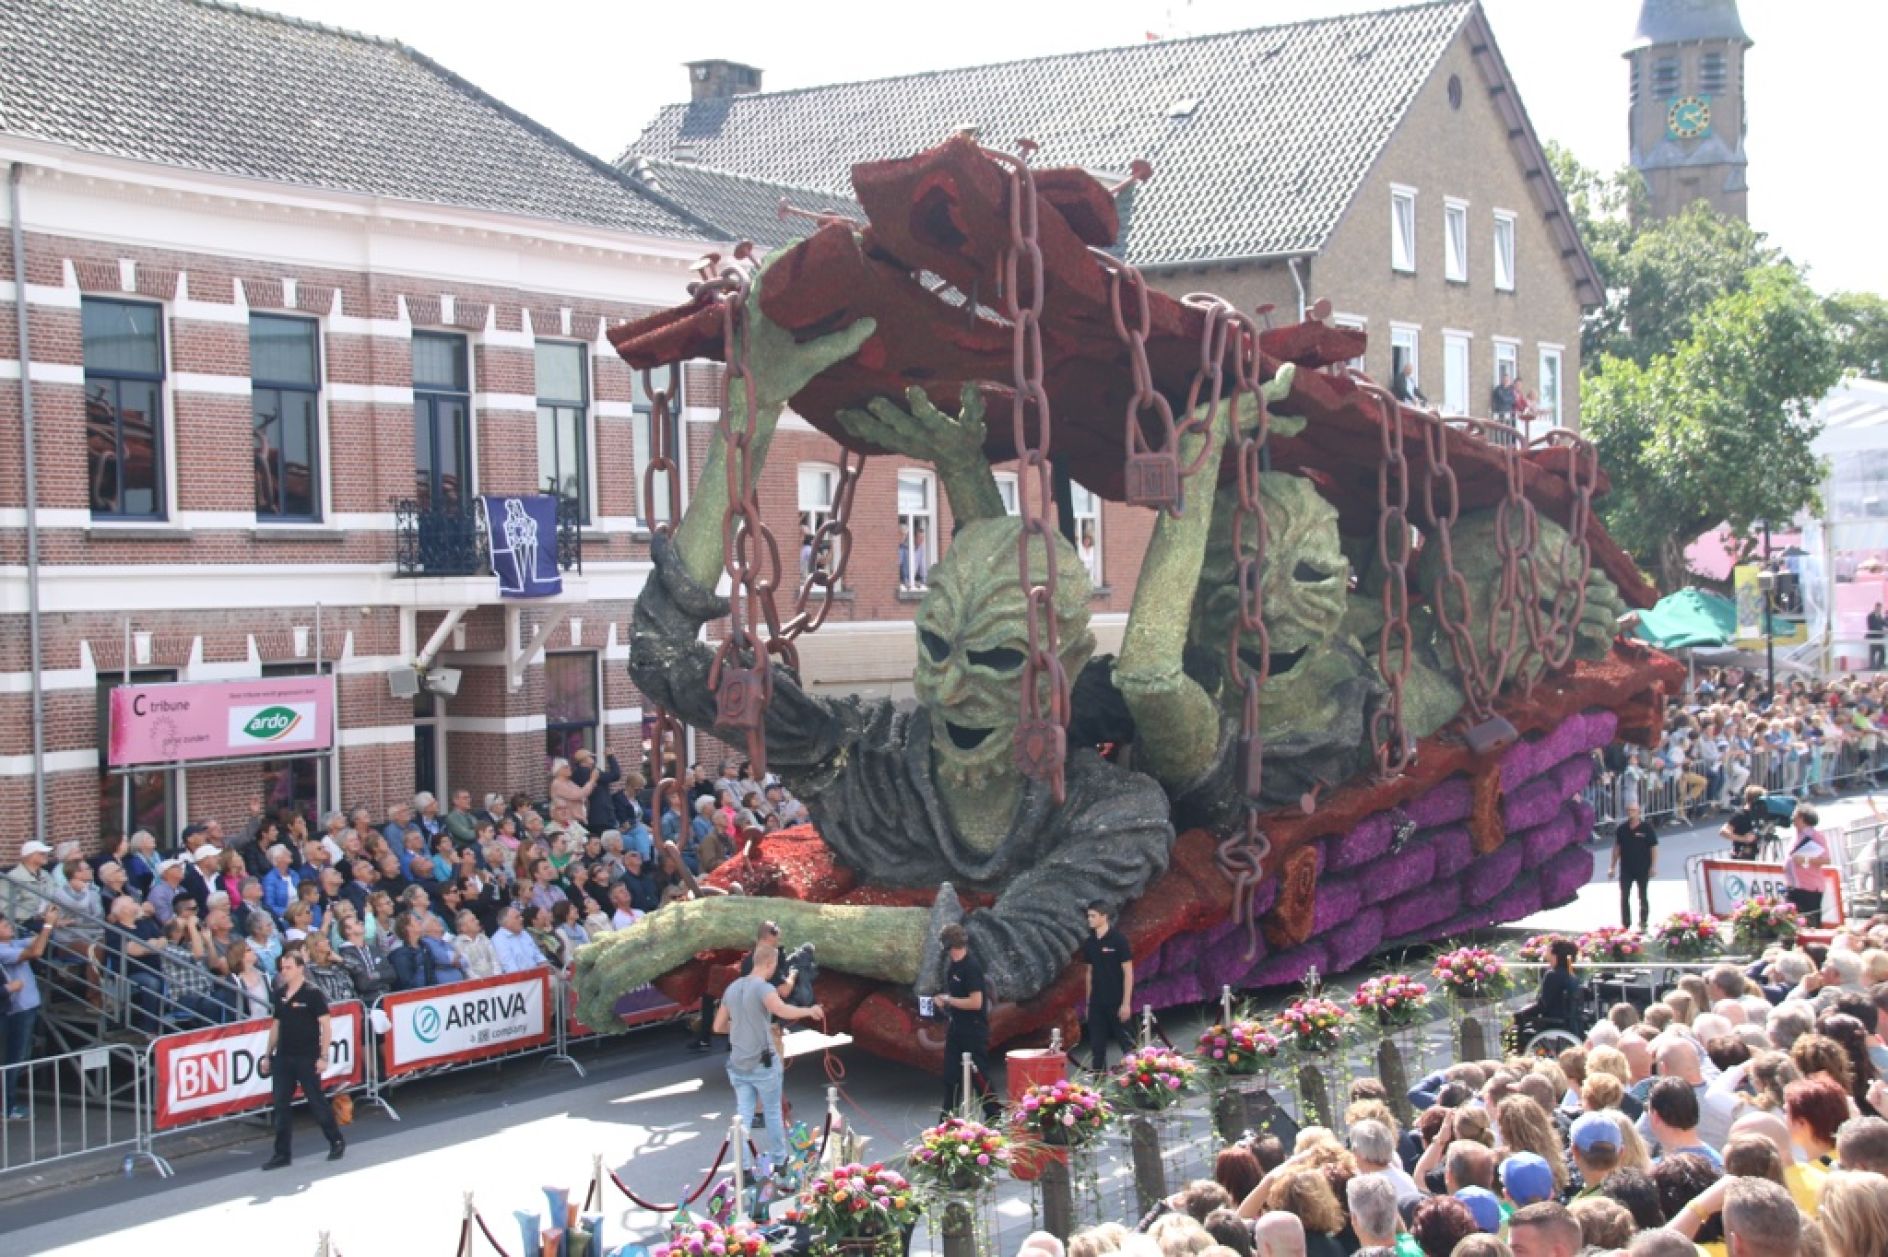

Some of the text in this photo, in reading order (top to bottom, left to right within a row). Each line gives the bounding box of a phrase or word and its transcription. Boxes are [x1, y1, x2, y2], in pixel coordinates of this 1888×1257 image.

[133, 693, 191, 717] C tribune
[250, 712, 289, 730] ardo
[445, 991, 528, 1031] ARRIVA
[178, 1053, 225, 1098] BN
